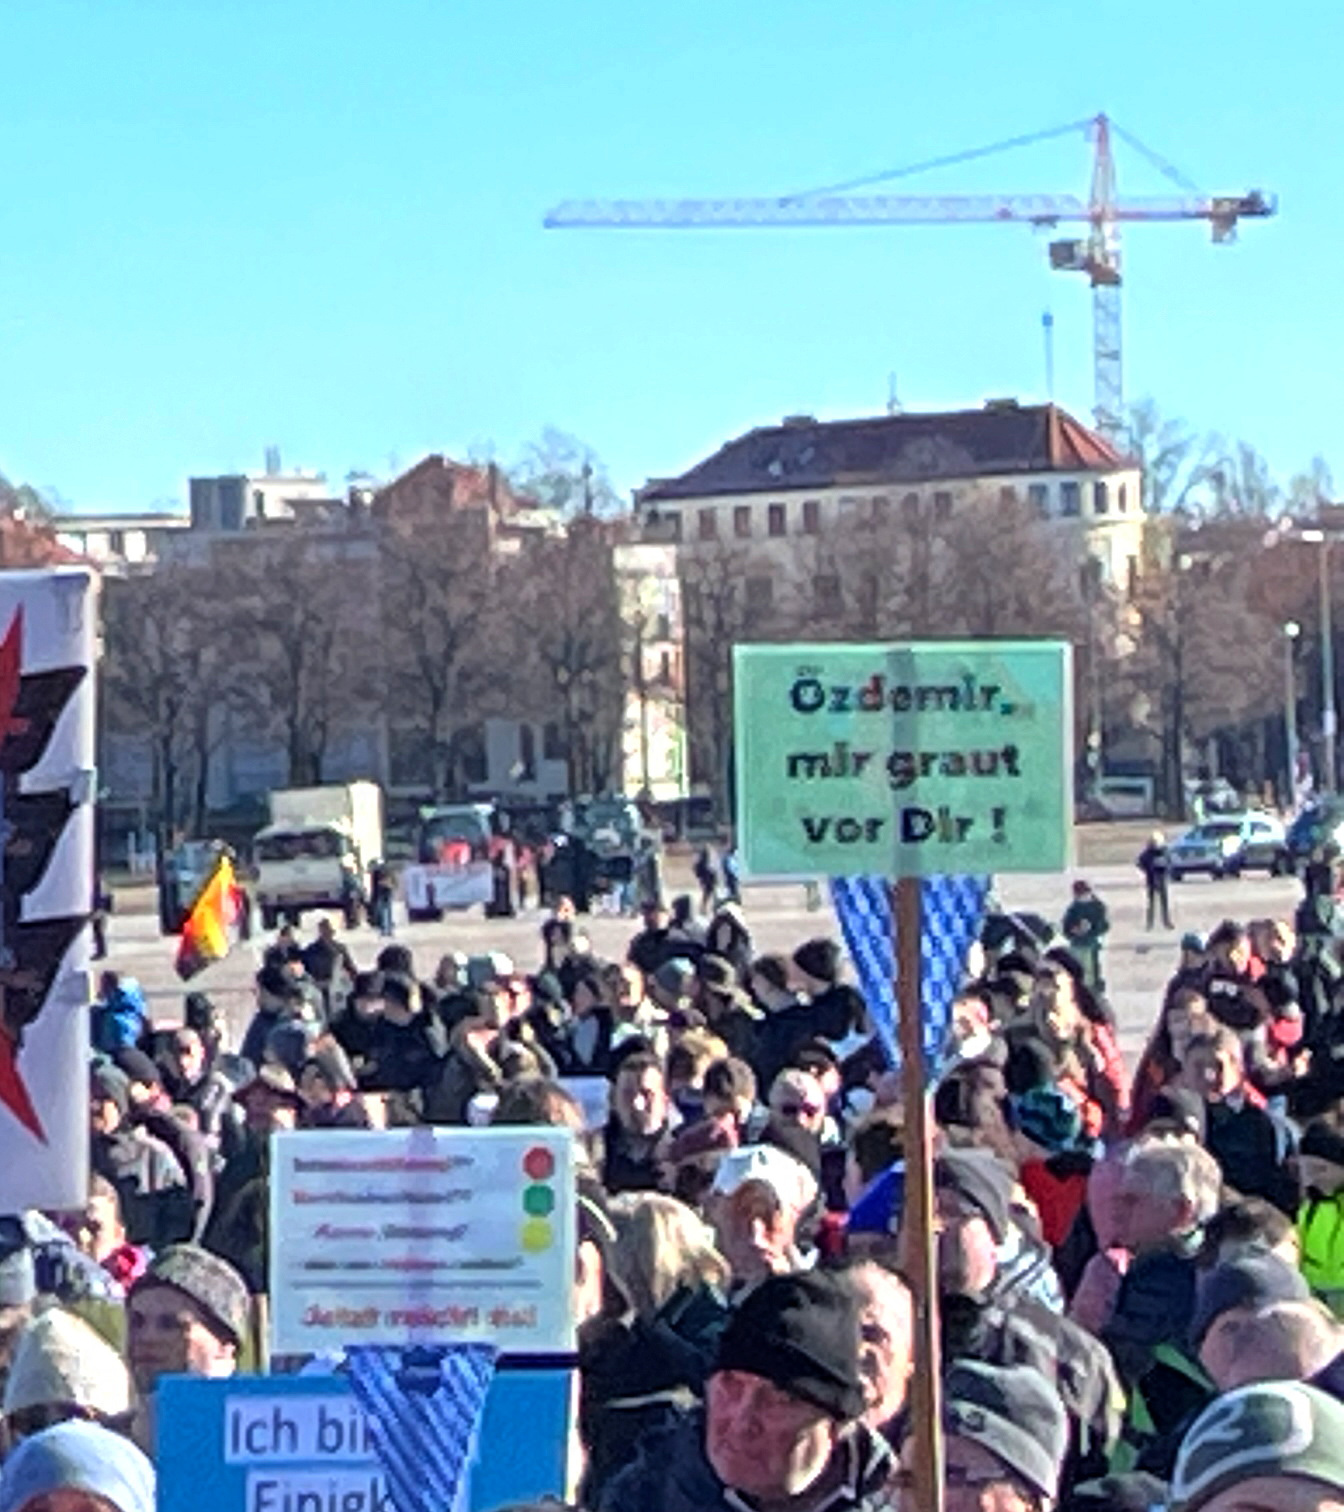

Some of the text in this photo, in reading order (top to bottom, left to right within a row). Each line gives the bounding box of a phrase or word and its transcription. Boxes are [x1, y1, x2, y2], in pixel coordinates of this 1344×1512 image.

[785, 741, 1022, 790] mir graut
[801, 814, 885, 844] vor
[899, 806, 975, 845] Dir
[231, 1405, 299, 1455] Ich
